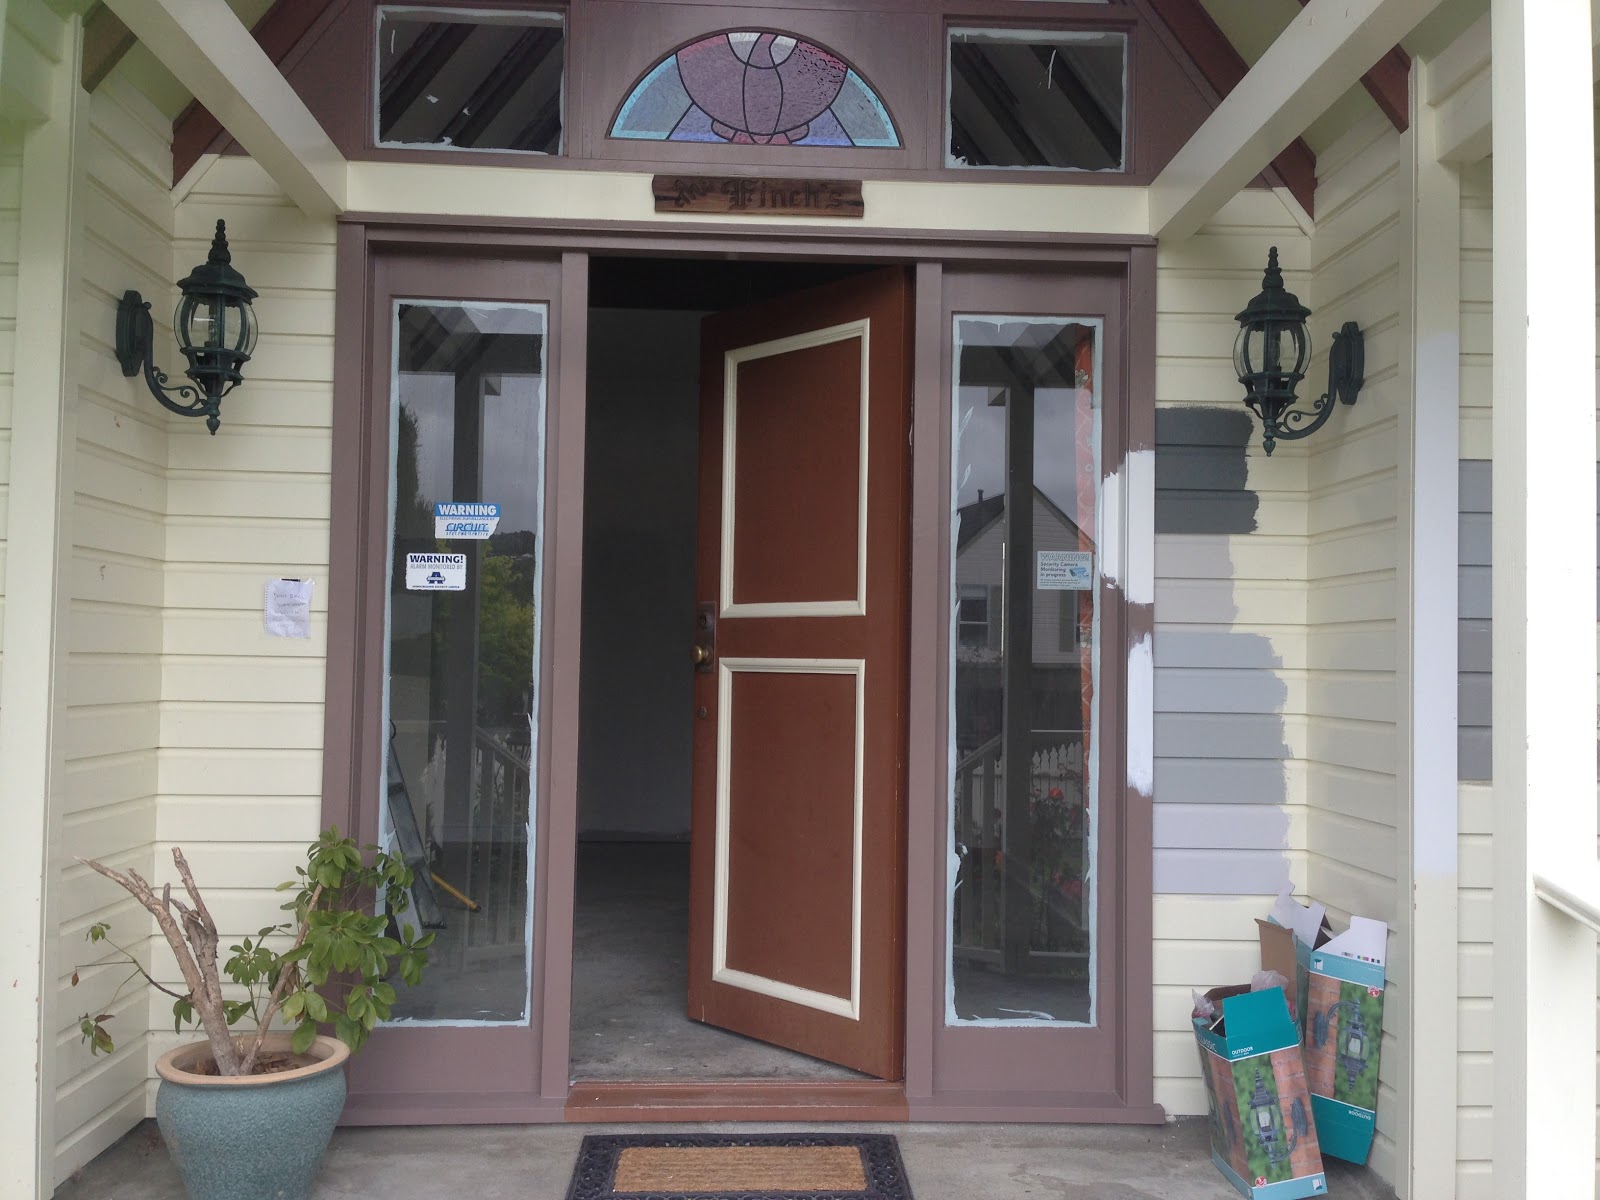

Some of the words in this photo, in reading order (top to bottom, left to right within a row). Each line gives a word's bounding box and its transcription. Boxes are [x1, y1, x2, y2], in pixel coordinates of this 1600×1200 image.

[721, 178, 842, 210] Finch's
[438, 504, 497, 516] WARNING
[445, 522, 489, 532] CIRCUIT
[410, 555, 463, 564] WARNING!
[1232, 1046, 1254, 1055] OUTDOOR
